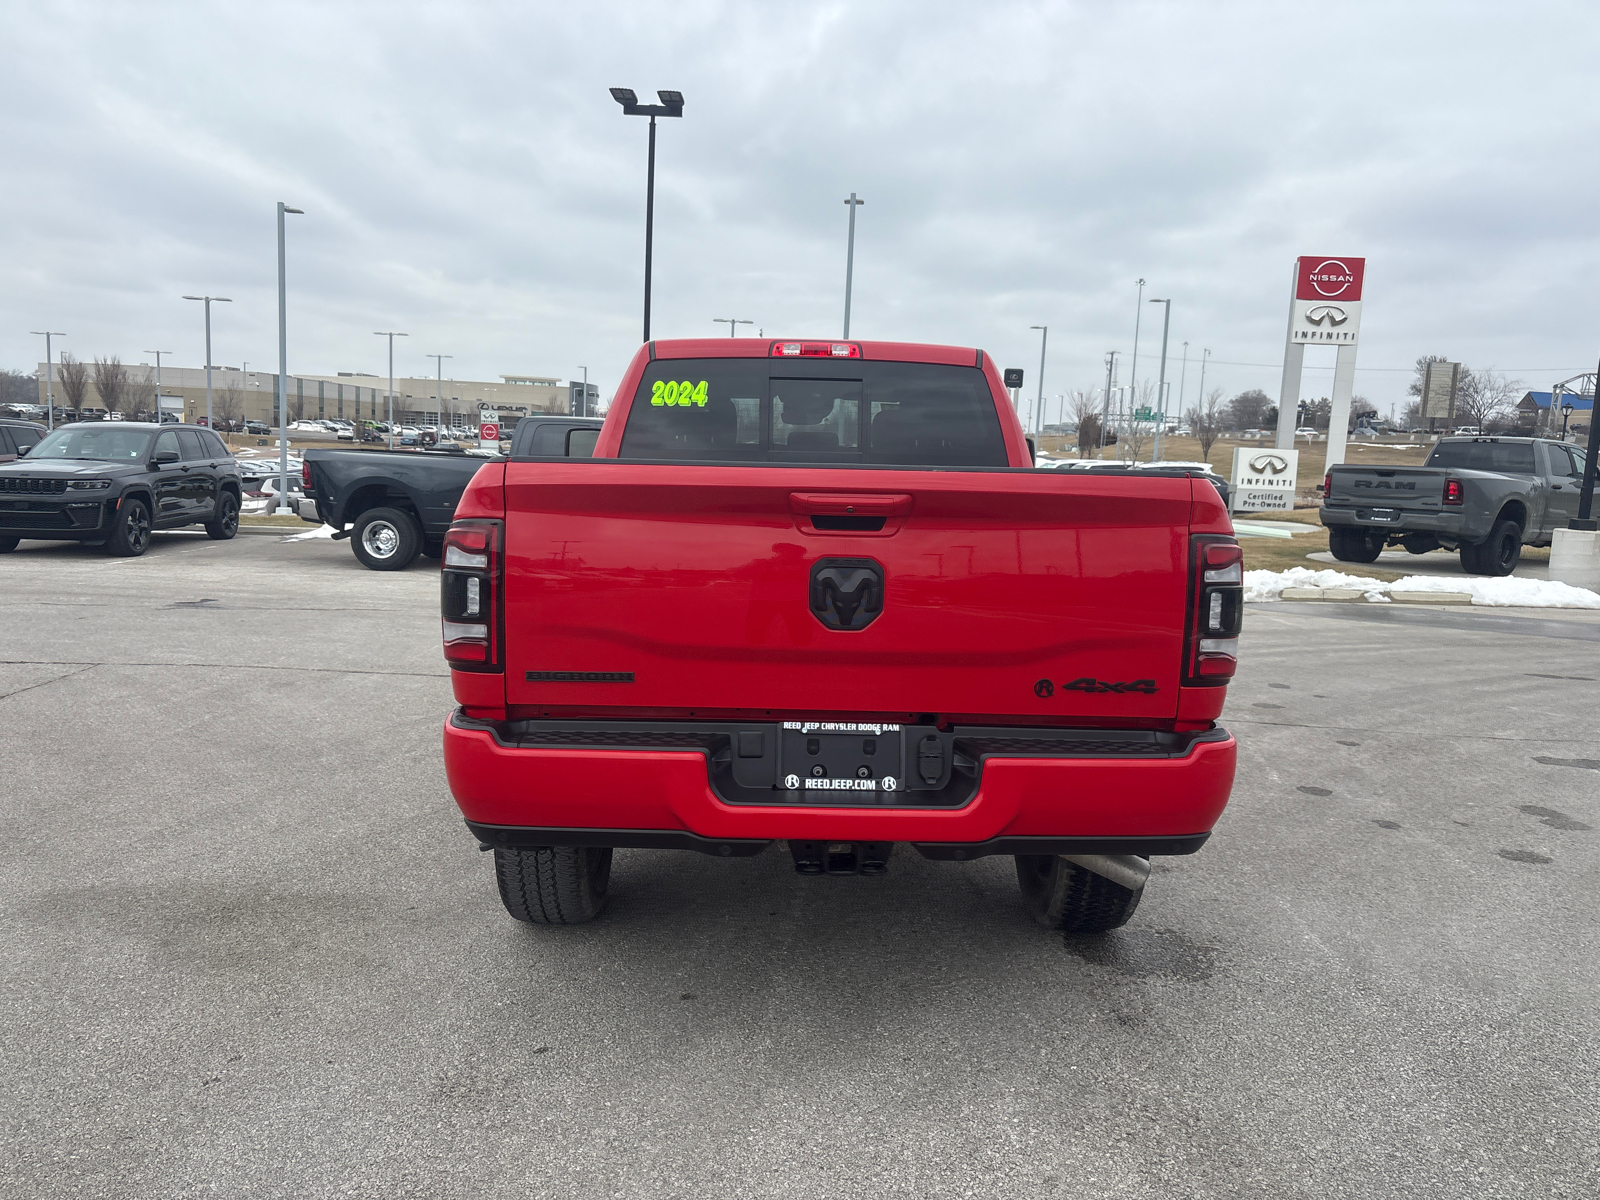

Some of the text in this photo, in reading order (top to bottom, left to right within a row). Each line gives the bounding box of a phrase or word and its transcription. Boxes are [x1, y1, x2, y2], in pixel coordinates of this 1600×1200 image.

[1309, 274, 1354, 282] NISSAN
[1294, 330, 1355, 341] INFINITI
[650, 380, 709, 407] 2024
[1241, 477, 1292, 487] INFINITI
[1354, 479, 1416, 491] RAM
[1247, 492, 1283, 501] Certified
[1242, 500, 1286, 509] Pre-Owned
[1061, 677, 1160, 695] 4x4
[783, 721, 900, 732] REED JEEP CHRYSLER DODGE RAM
[805, 778, 876, 790] REEDJEEP.COM
